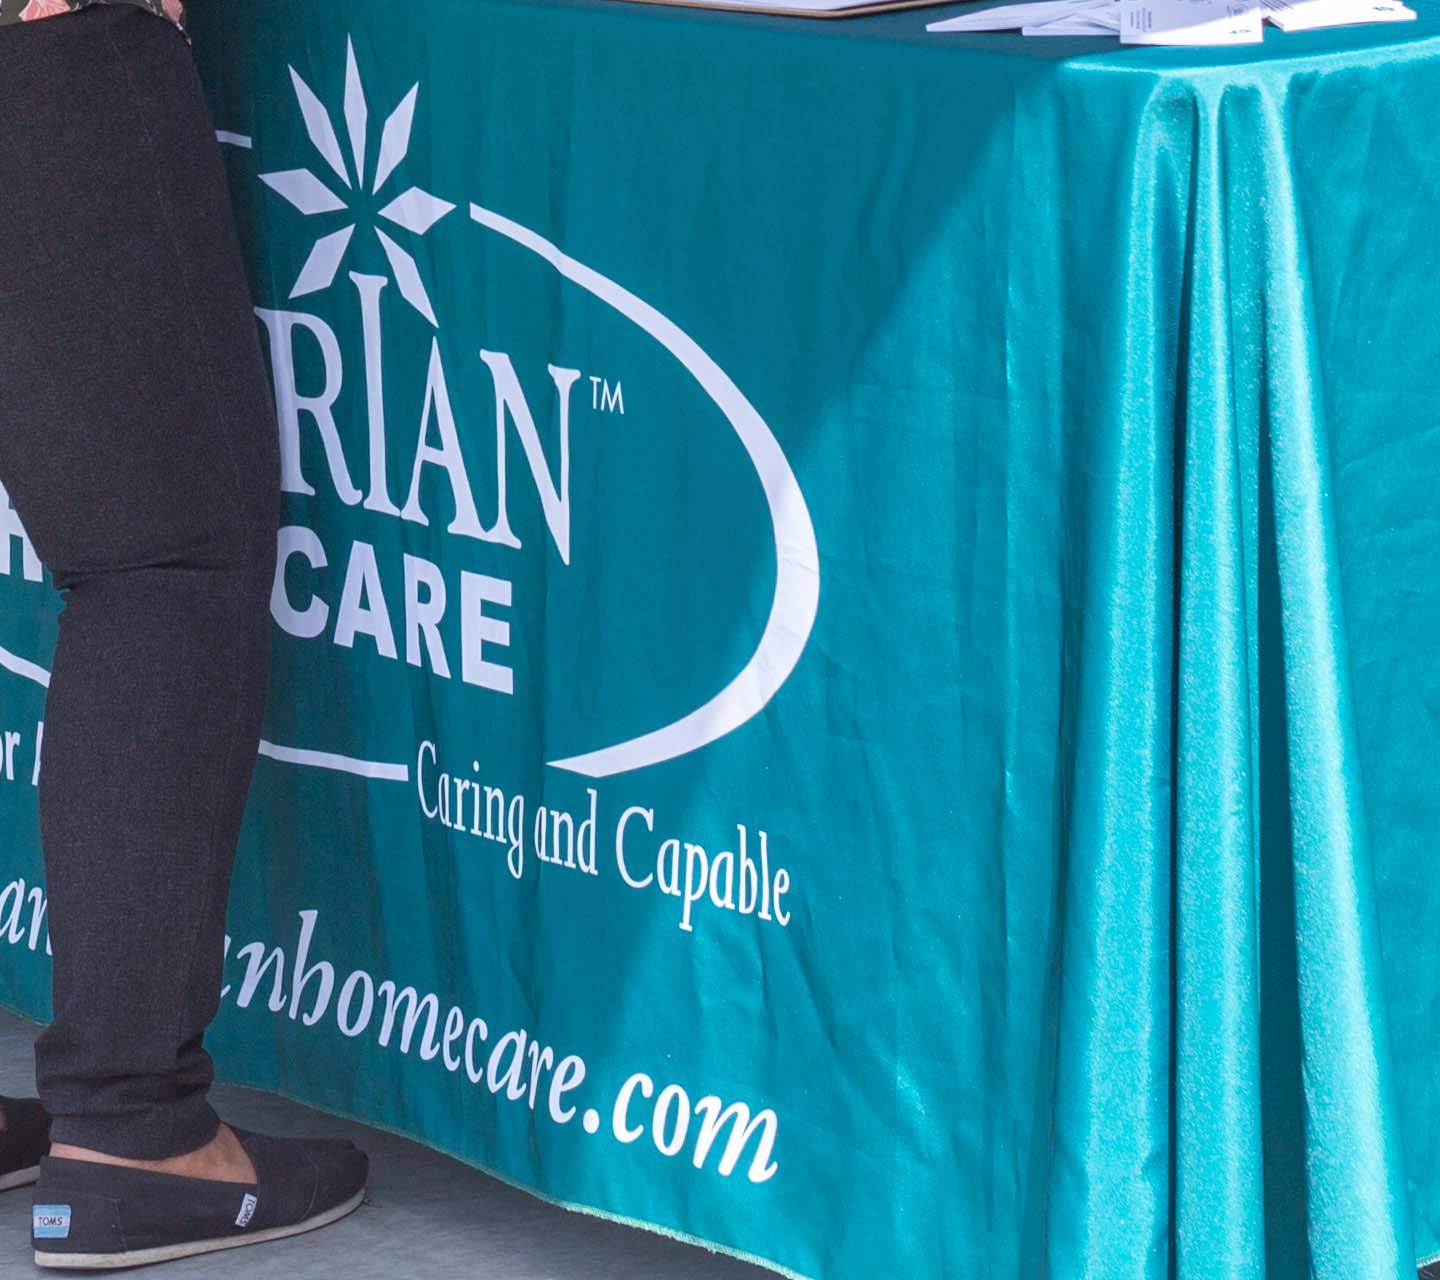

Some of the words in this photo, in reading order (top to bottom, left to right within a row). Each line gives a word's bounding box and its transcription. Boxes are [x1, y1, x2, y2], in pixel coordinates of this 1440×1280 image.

[417, 740, 525, 880] Caring
[534, 788, 599, 876] and
[615, 806, 791, 932] Capable
[221, 909, 779, 1184] nhomecare.com
[38, 1216, 64, 1226] TOMS
